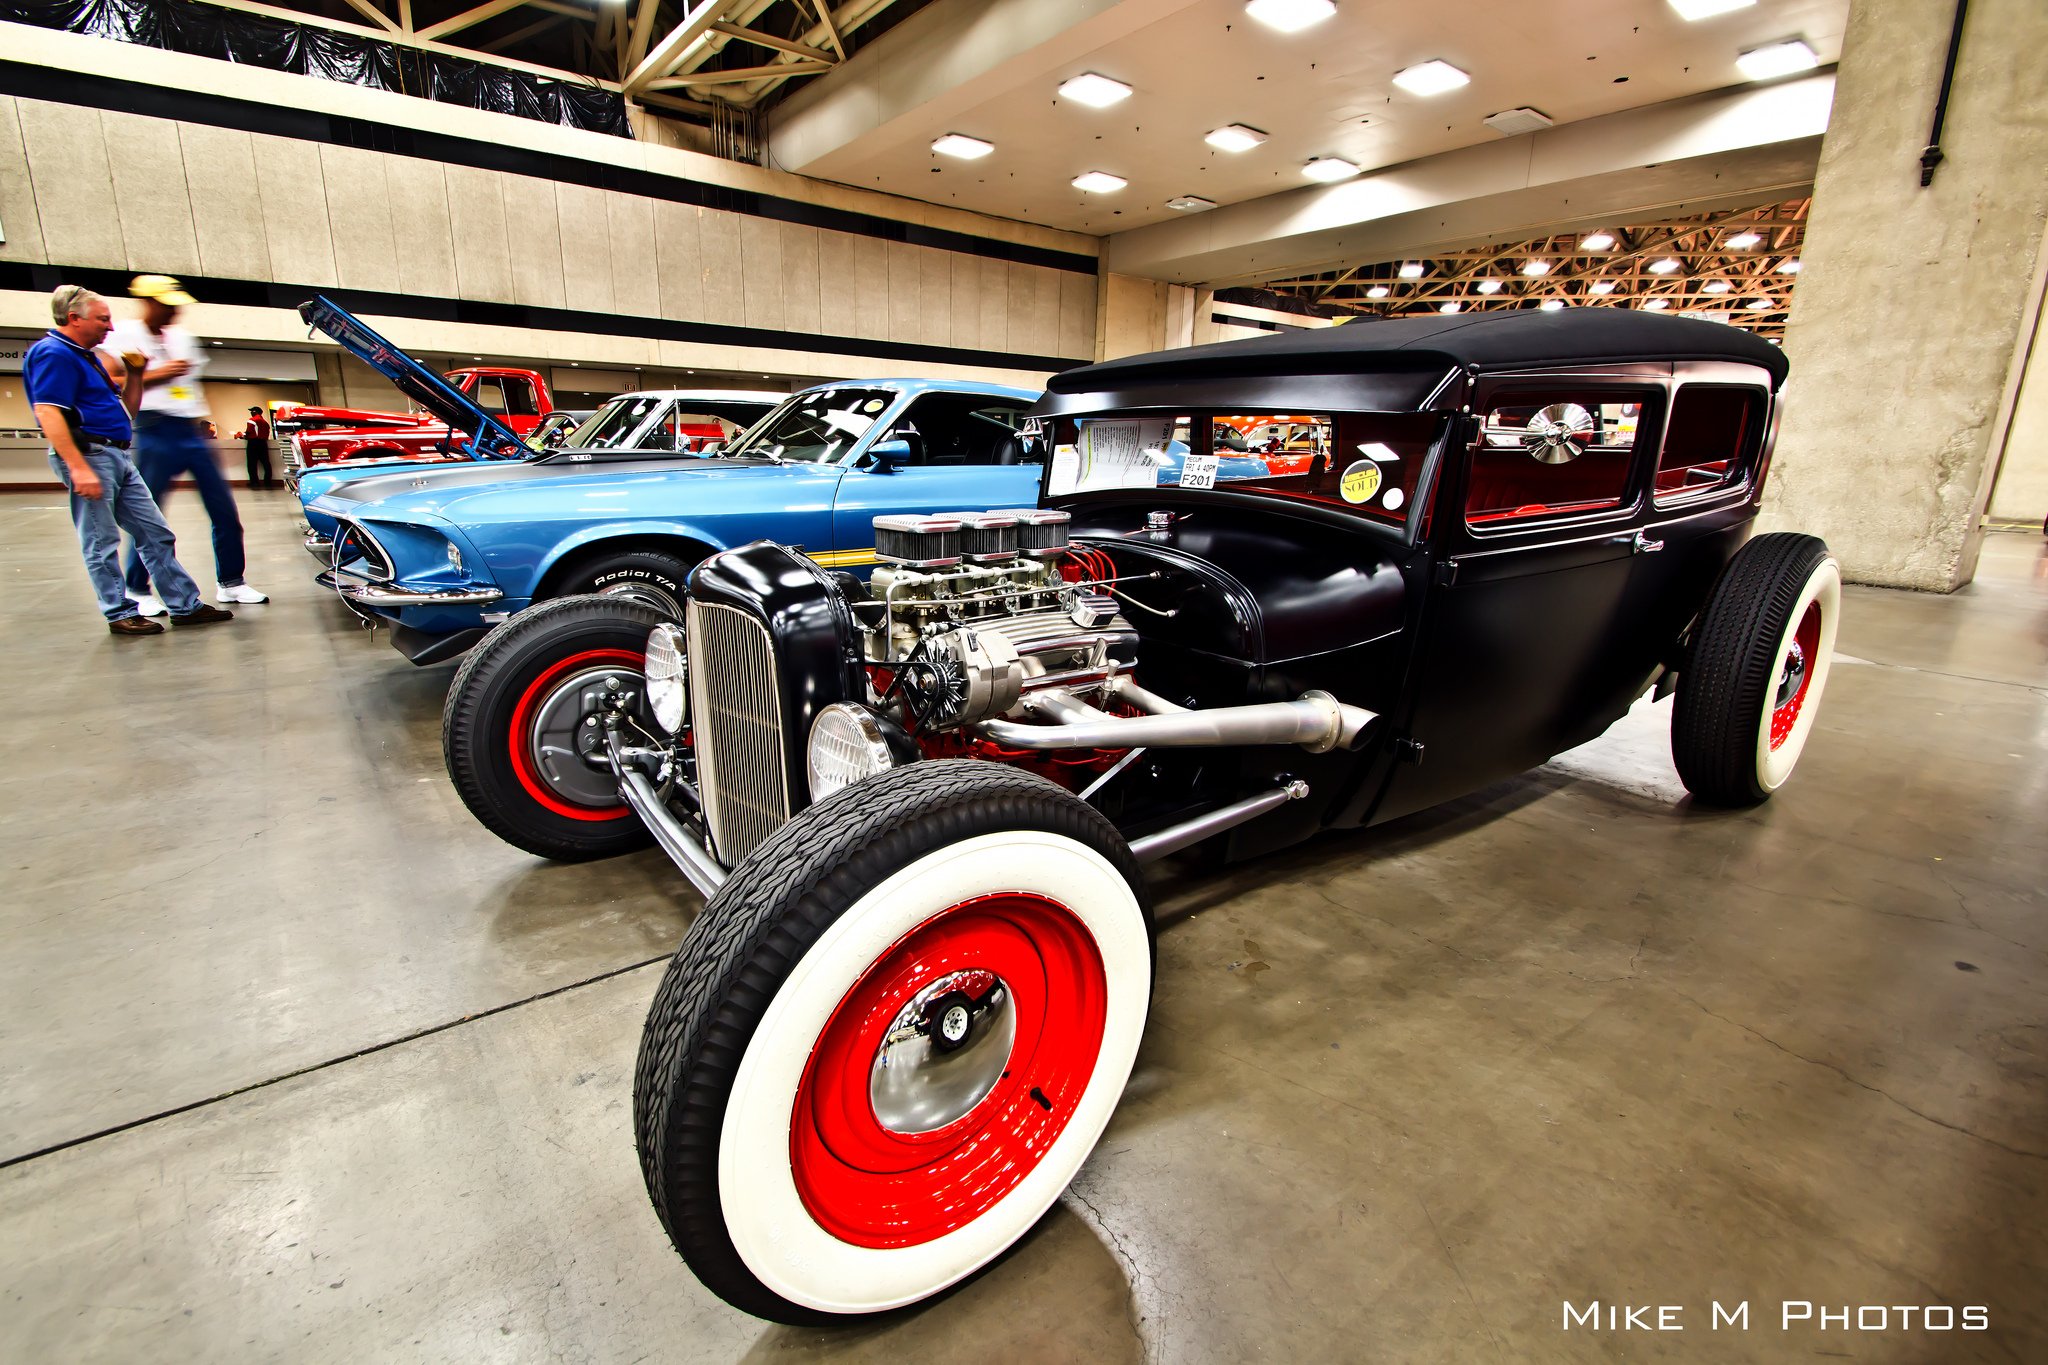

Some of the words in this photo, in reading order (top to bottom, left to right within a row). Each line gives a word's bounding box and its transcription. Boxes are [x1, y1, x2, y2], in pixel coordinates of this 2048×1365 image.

[1182, 474, 1211, 486] F201
[1345, 478, 1378, 493] SOLD
[594, 570, 650, 586] Radial
[655, 575, 676, 591] T/A
